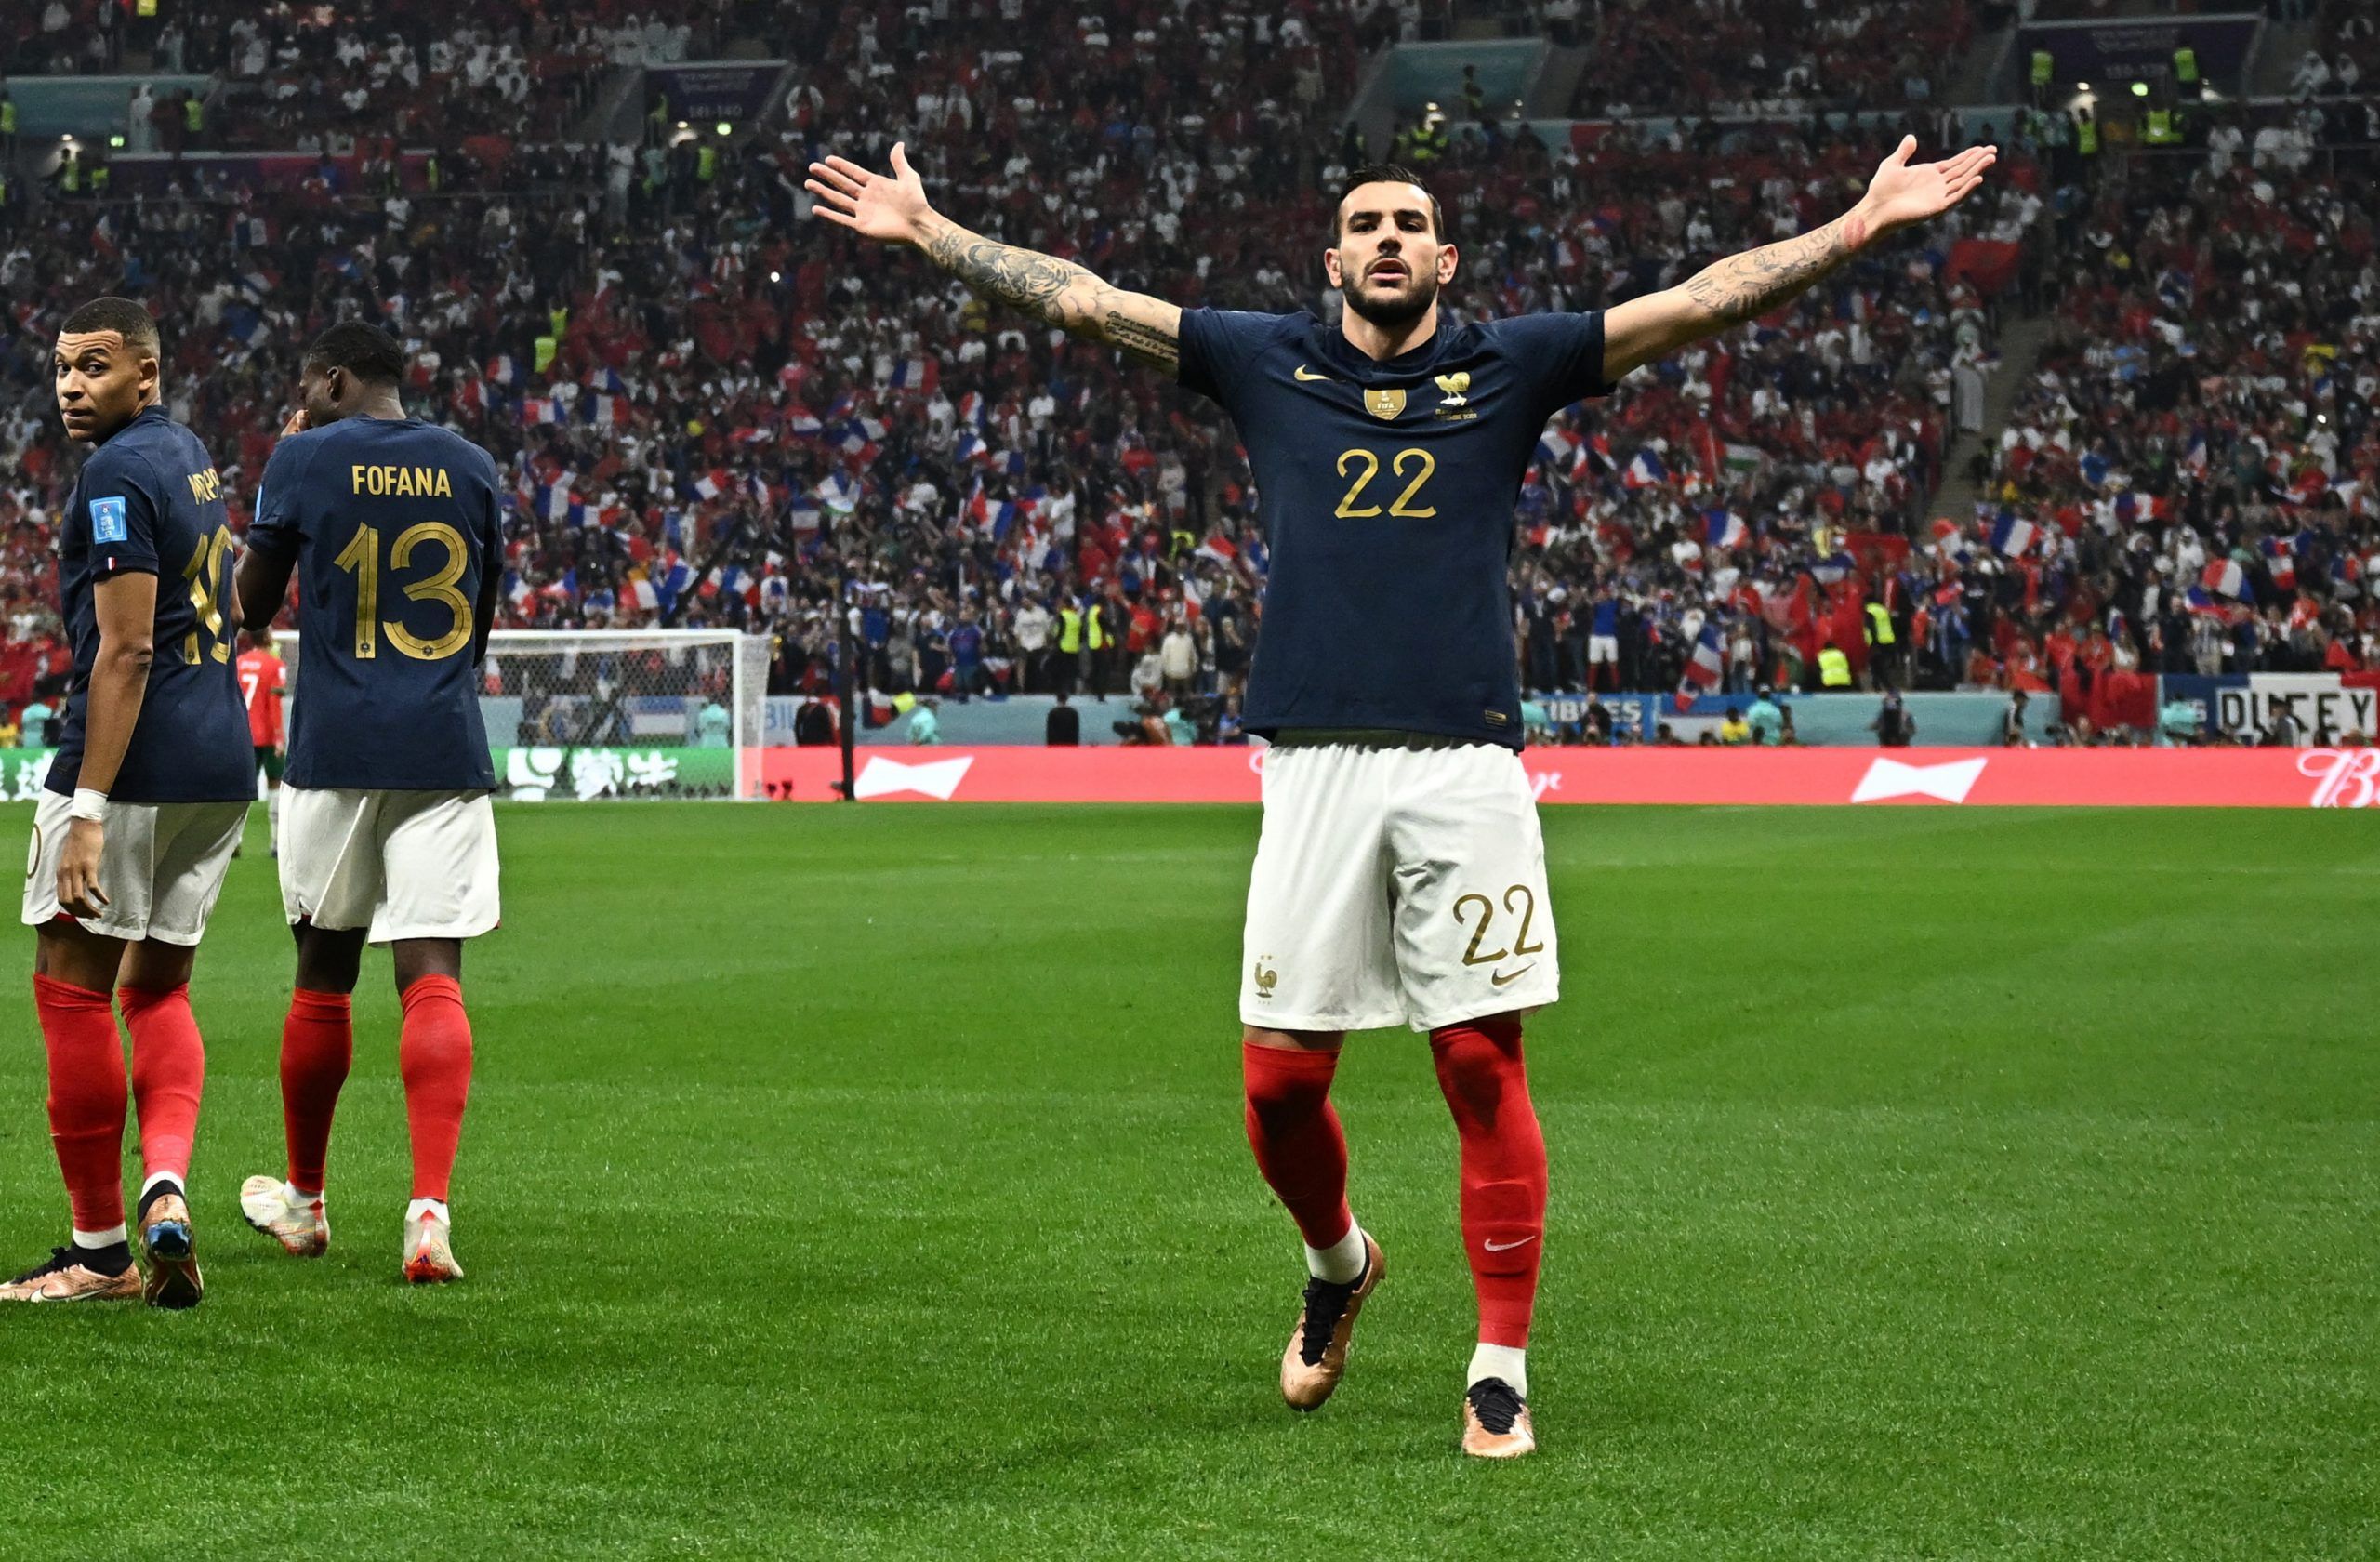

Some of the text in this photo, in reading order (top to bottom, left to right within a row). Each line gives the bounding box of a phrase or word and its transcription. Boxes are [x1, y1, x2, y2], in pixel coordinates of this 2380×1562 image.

[1377, 402, 1395, 410] FIFA
[351, 465, 453, 497] FOFANA
[1334, 448, 1436, 519] 22
[335, 522, 474, 661] 13
[242, 673, 259, 711] 7
[1453, 884, 1545, 967] 22
